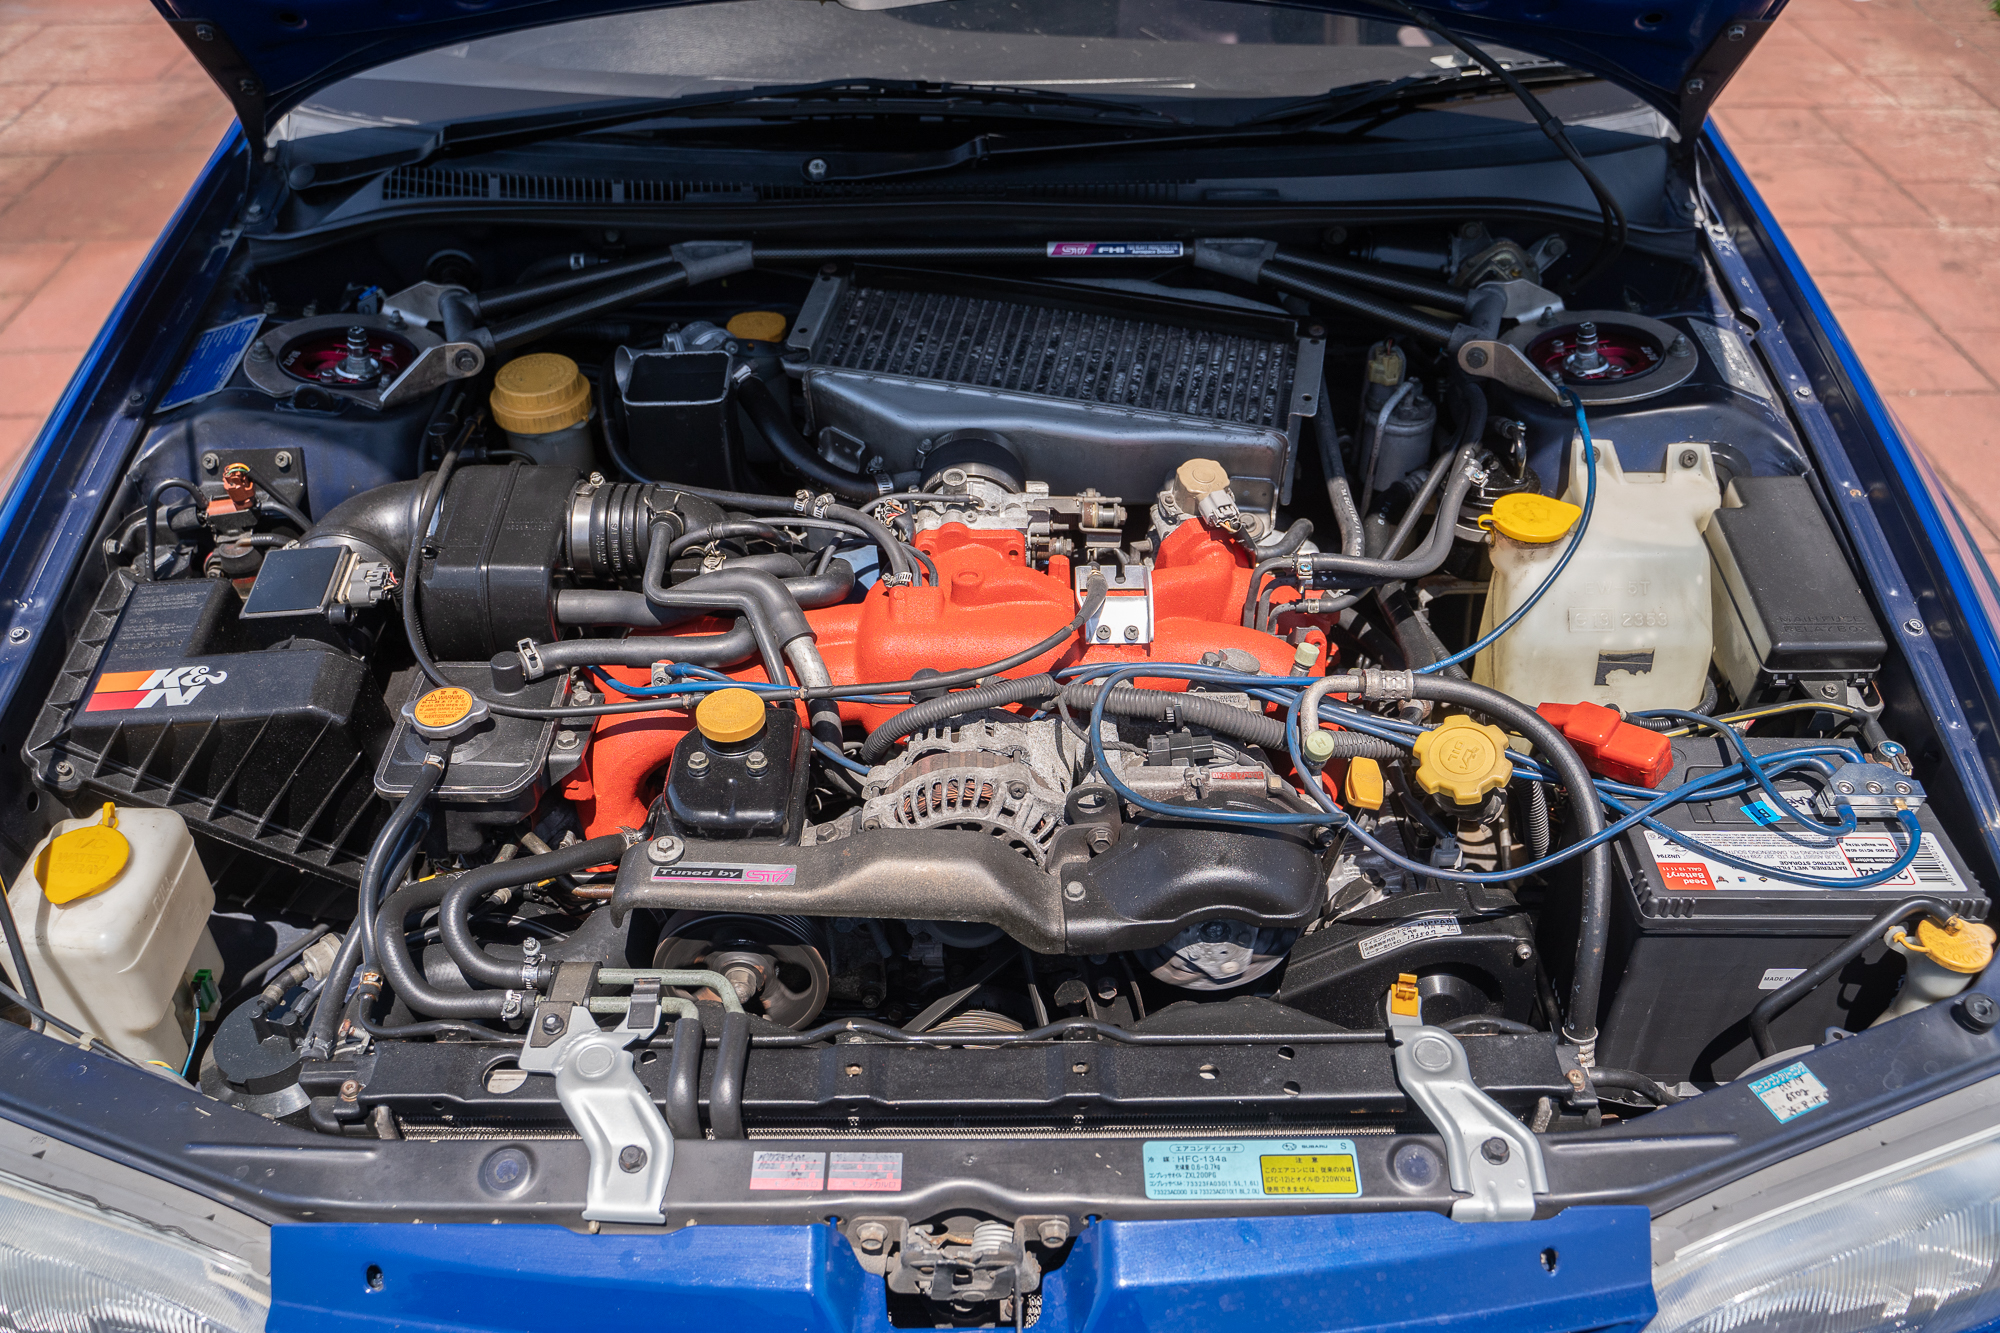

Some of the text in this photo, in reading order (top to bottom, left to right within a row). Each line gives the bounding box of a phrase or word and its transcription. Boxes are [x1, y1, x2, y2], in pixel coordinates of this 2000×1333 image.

[1584, 580, 1652, 596] EW-5T
[1622, 612, 1668, 627] 2353
[1448, 740, 1464, 762] OIL
[74, 838, 109, 849] I/C
[57, 852, 110, 864] WATER
[50, 862, 105, 875] SPRAY
[717, 870, 740, 878] by
